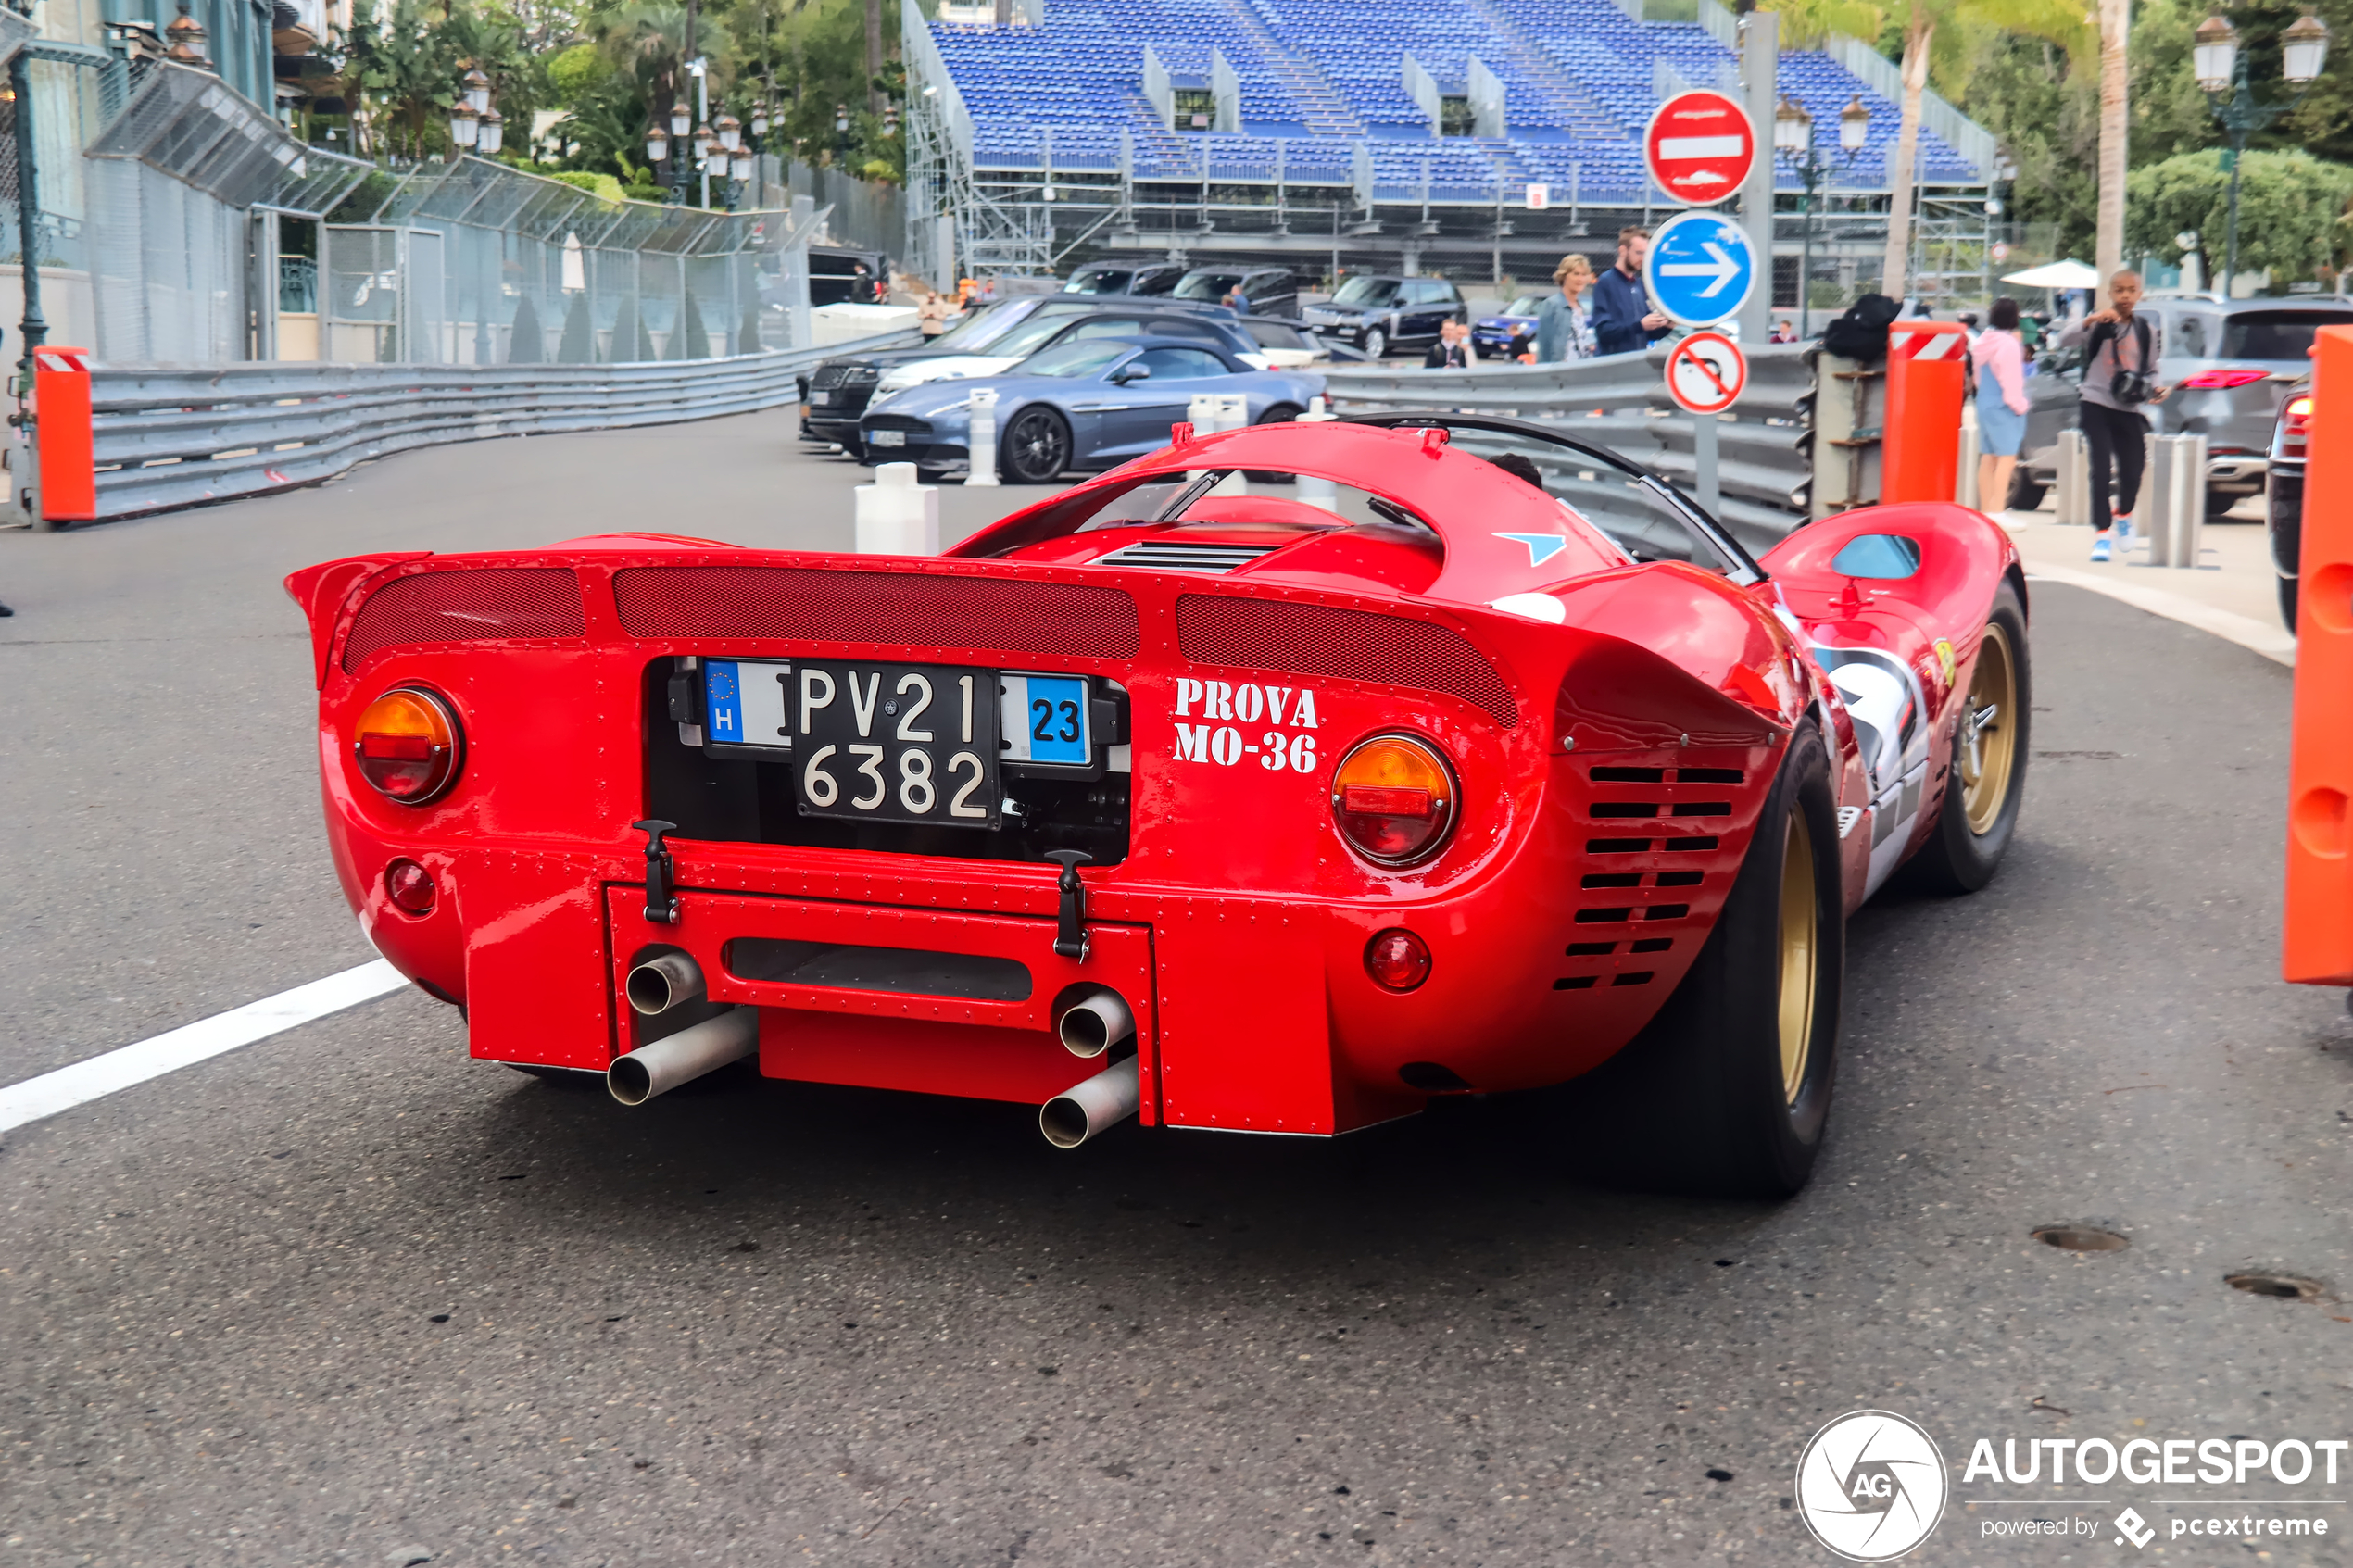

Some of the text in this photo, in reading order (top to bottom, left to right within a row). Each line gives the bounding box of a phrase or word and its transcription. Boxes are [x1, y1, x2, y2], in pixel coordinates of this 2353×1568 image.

[714, 708, 733, 731] H
[1032, 698, 1080, 743] 23
[1174, 677, 1319, 729] PROVA
[1172, 722, 1317, 774] MO-36
[803, 744, 988, 819] 6382
